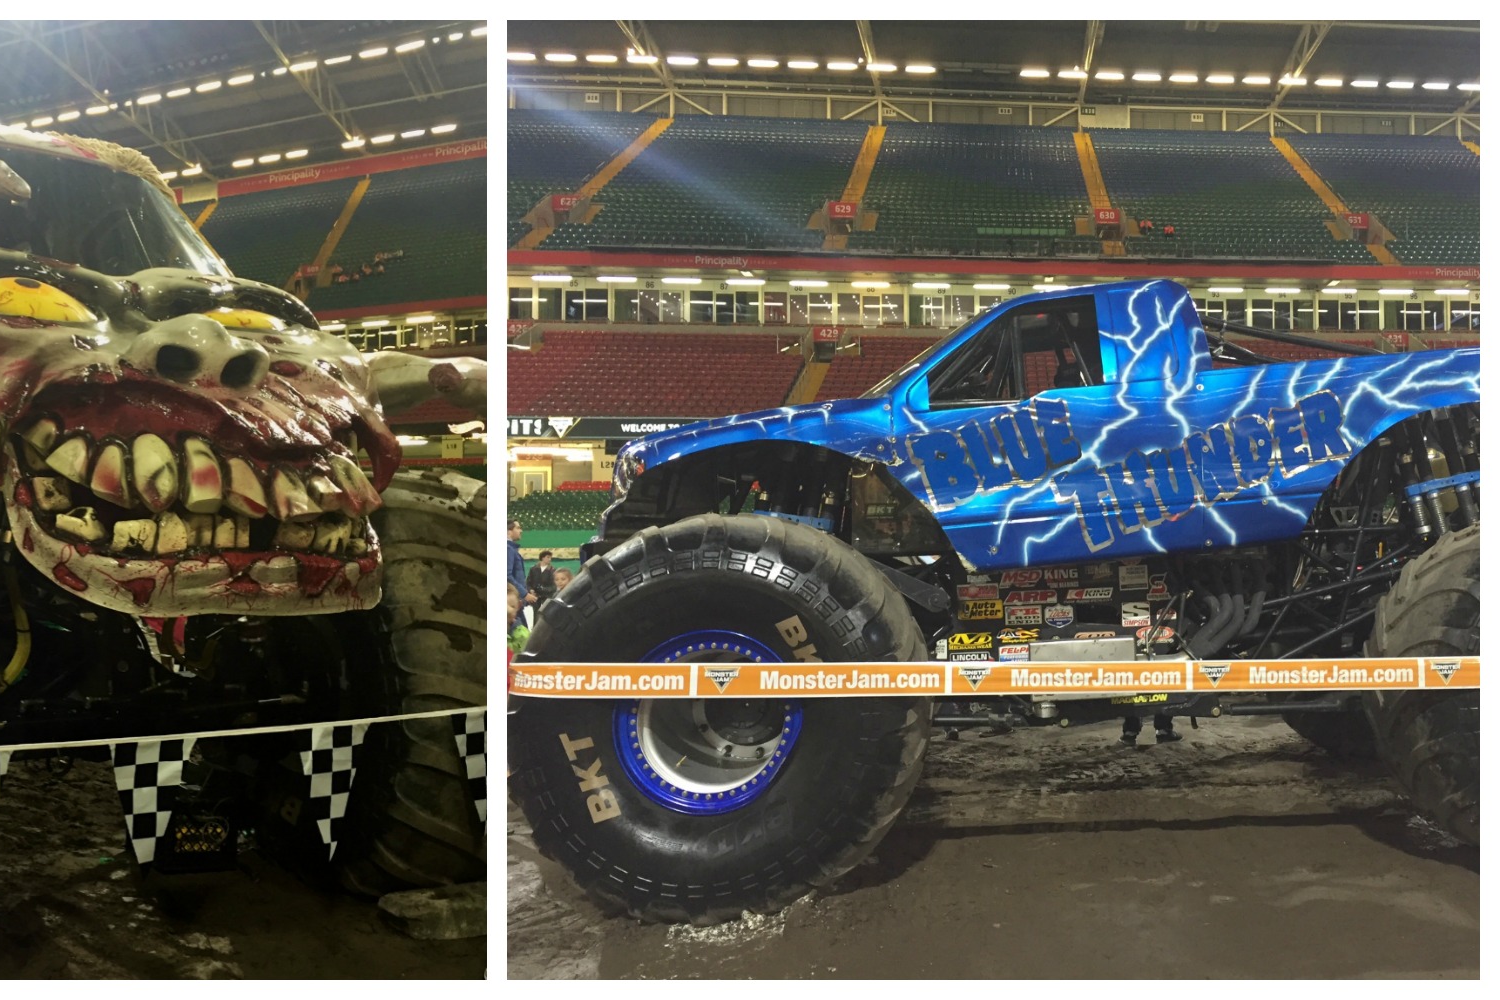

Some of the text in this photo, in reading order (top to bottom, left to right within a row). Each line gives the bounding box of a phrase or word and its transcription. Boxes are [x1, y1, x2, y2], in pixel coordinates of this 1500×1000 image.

[268, 168, 321, 184] Principality
[835, 205, 852, 213] 629
[1100, 211, 1115, 220] 630
[695, 255, 749, 268] Principality
[819, 328, 839, 338] 429
[621, 423, 666, 432] WELCOME
[905, 396, 1082, 513] BLUE
[1051, 388, 1352, 553] THUNDER
[1001, 570, 1042, 584] MSD
[1044, 568, 1079, 579] KING
[1006, 590, 1056, 602] ARP
[971, 601, 996, 609] Auto
[970, 609, 1002, 618] Meter
[952, 653, 987, 661] LINCOLN
[514, 670, 684, 691] MonsterJam.com
[760, 670, 940, 690] MonsterJam.com
[1011, 668, 1181, 687] MonsterJam.com
[1249, 665, 1414, 684] MonsterJam.com
[559, 733, 622, 824] BKT
